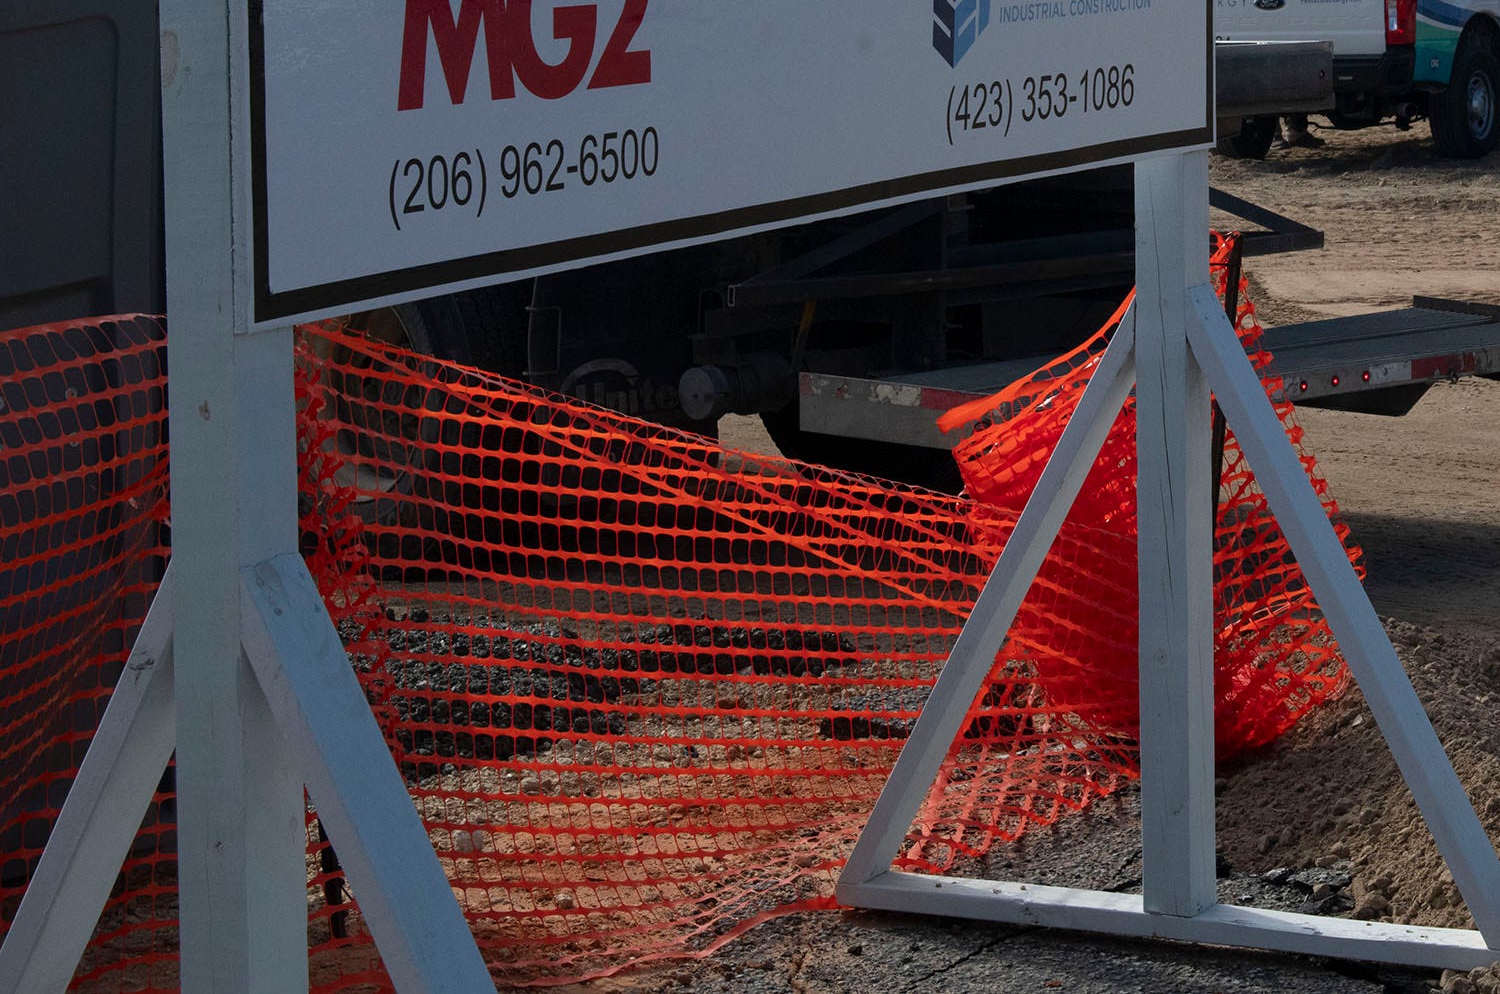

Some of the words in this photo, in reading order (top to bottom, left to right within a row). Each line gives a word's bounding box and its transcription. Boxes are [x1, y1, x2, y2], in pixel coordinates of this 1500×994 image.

[1000, 1, 1066, 24] INDUSTRIAL
[946, 78, 1013, 145] (423)
[1021, 63, 1135, 121] 353-1086
[388, 149, 488, 230] (206)
[500, 125, 660, 199] 962-6500
